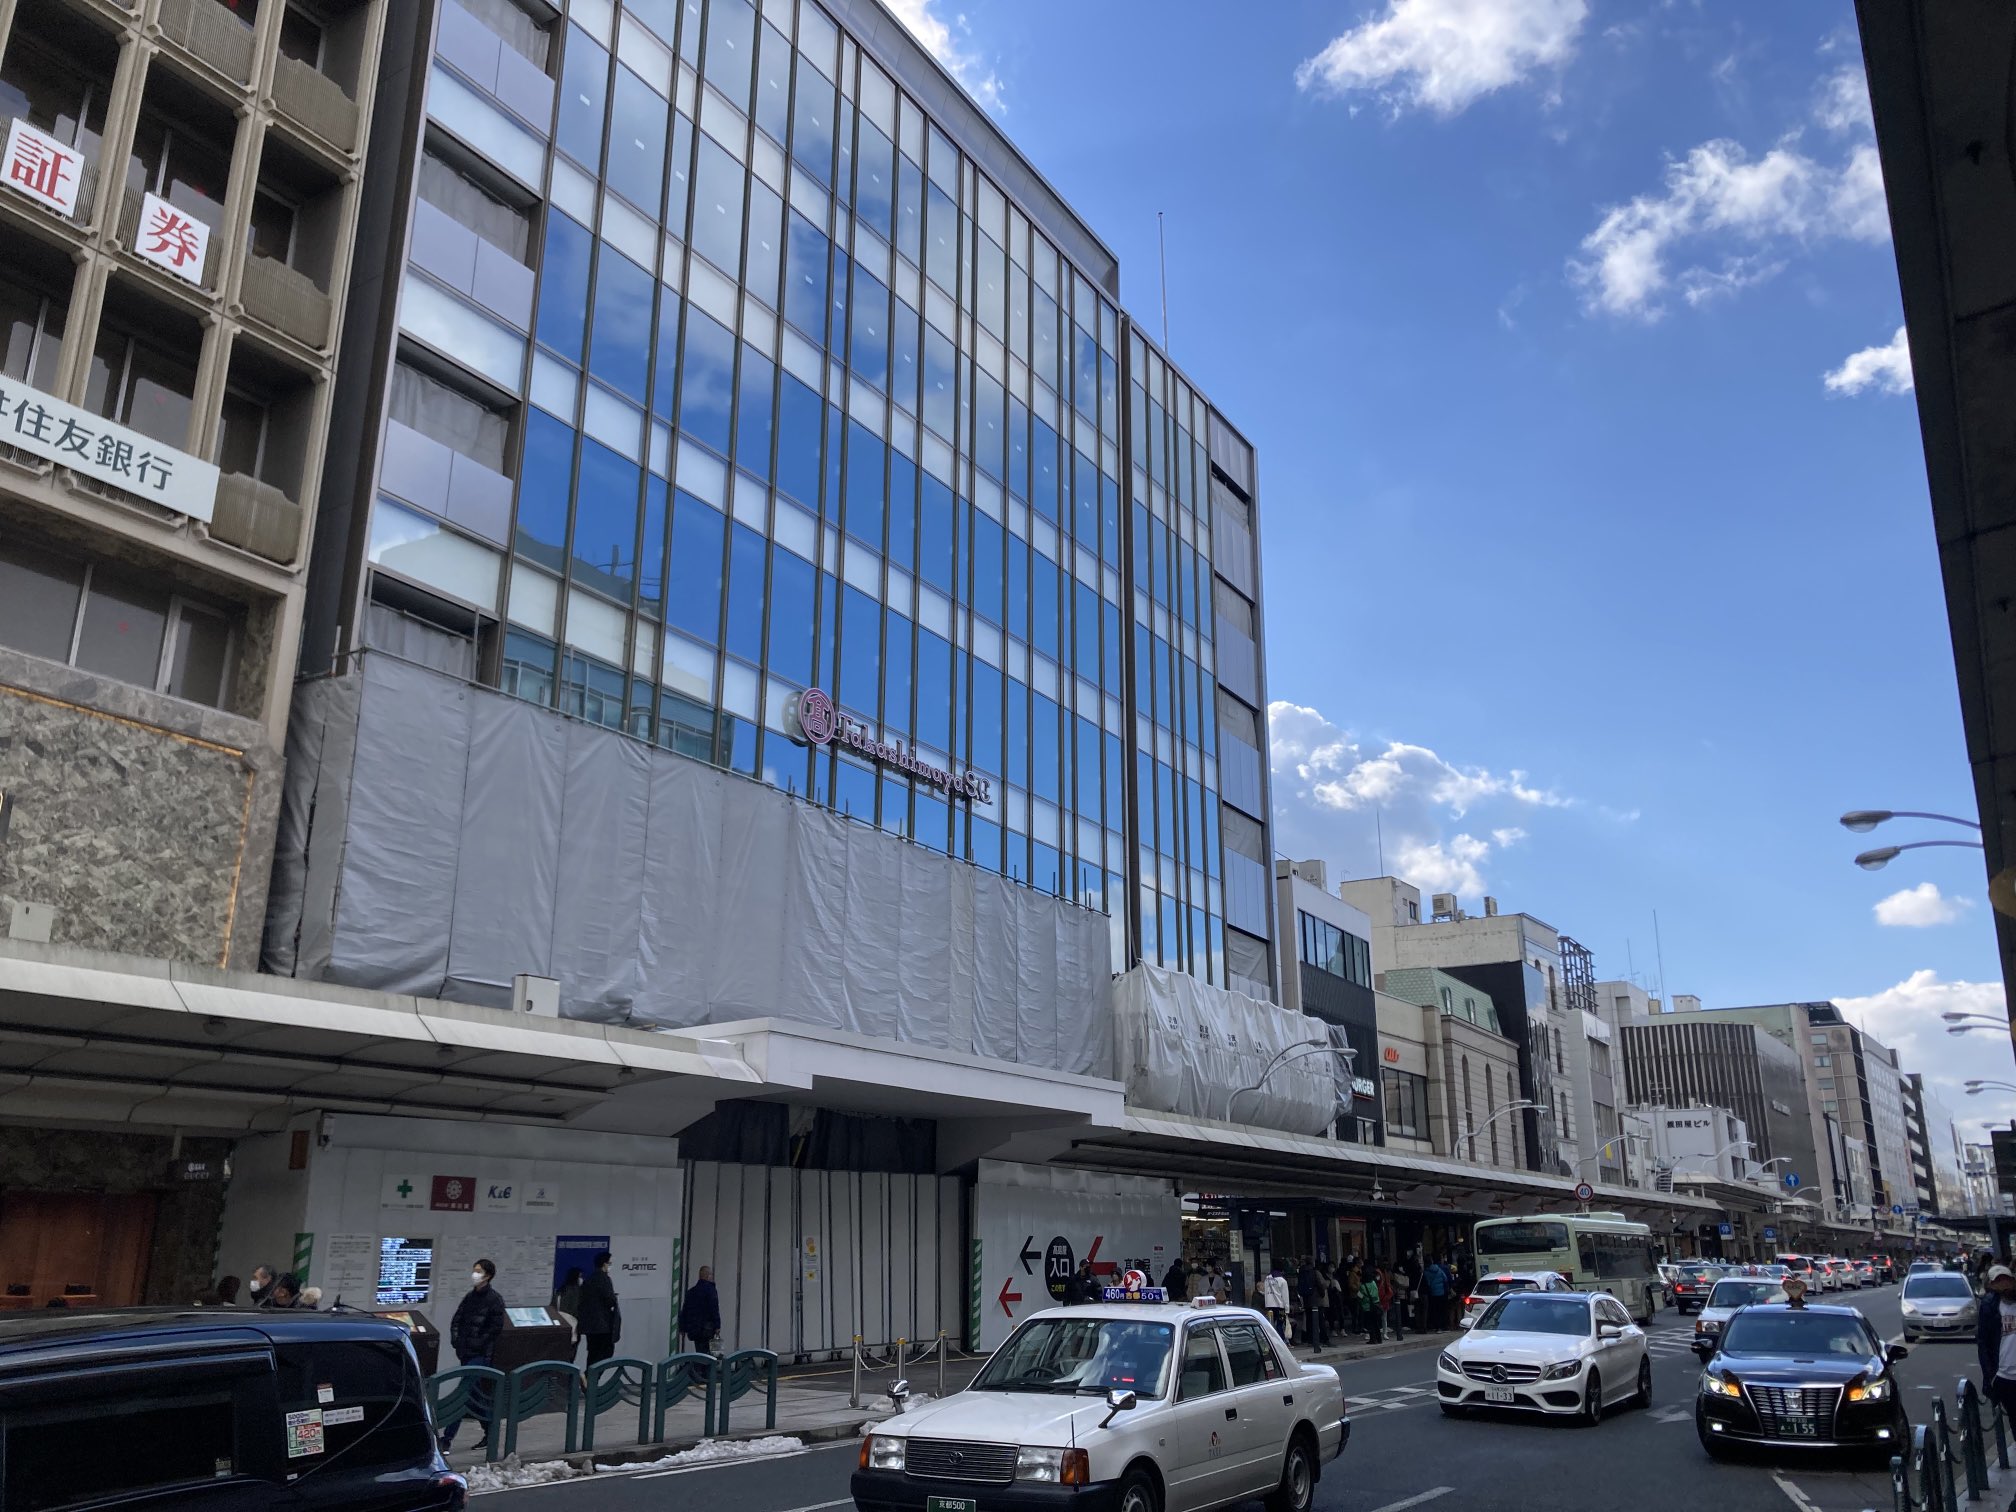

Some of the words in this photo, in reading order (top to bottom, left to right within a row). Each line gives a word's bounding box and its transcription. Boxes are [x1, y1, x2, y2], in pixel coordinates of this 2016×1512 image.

[11, 132, 74, 206] 証
[146, 207, 199, 267] 券
[1049, 1257, 1070, 1278] 入口
